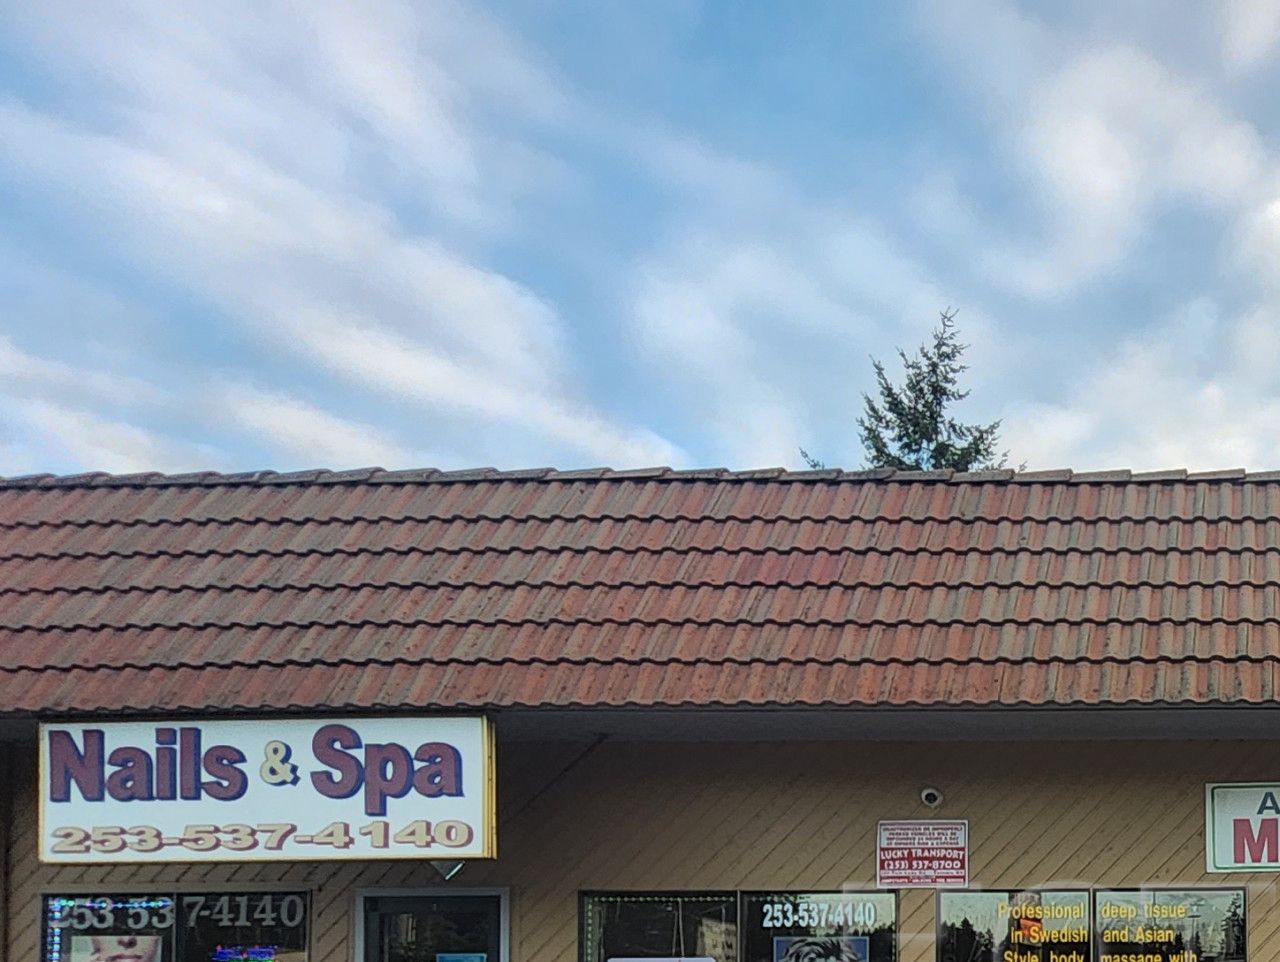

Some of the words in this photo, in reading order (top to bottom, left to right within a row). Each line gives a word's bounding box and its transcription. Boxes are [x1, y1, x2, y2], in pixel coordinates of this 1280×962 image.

[48, 727, 248, 802] Nails
[259, 740, 301, 787] &
[310, 724, 465, 817] Spa
[50, 820, 474, 854] 253-537-4140
[880, 849, 910, 860] LUCKY
[911, 848, 965, 860] TRANSPORT
[884, 861, 909, 870] (253)
[911, 860, 961, 870] 537-8700
[762, 902, 876, 928] 253-537-4140
[997, 902, 1085, 919] Professional
[1101, 902, 1137, 920] deep
[1144, 902, 1186, 918] tissue
[1030, 926, 1088, 944] Swedish
[1103, 926, 1129, 943] and
[1134, 926, 1175, 943] Asian
